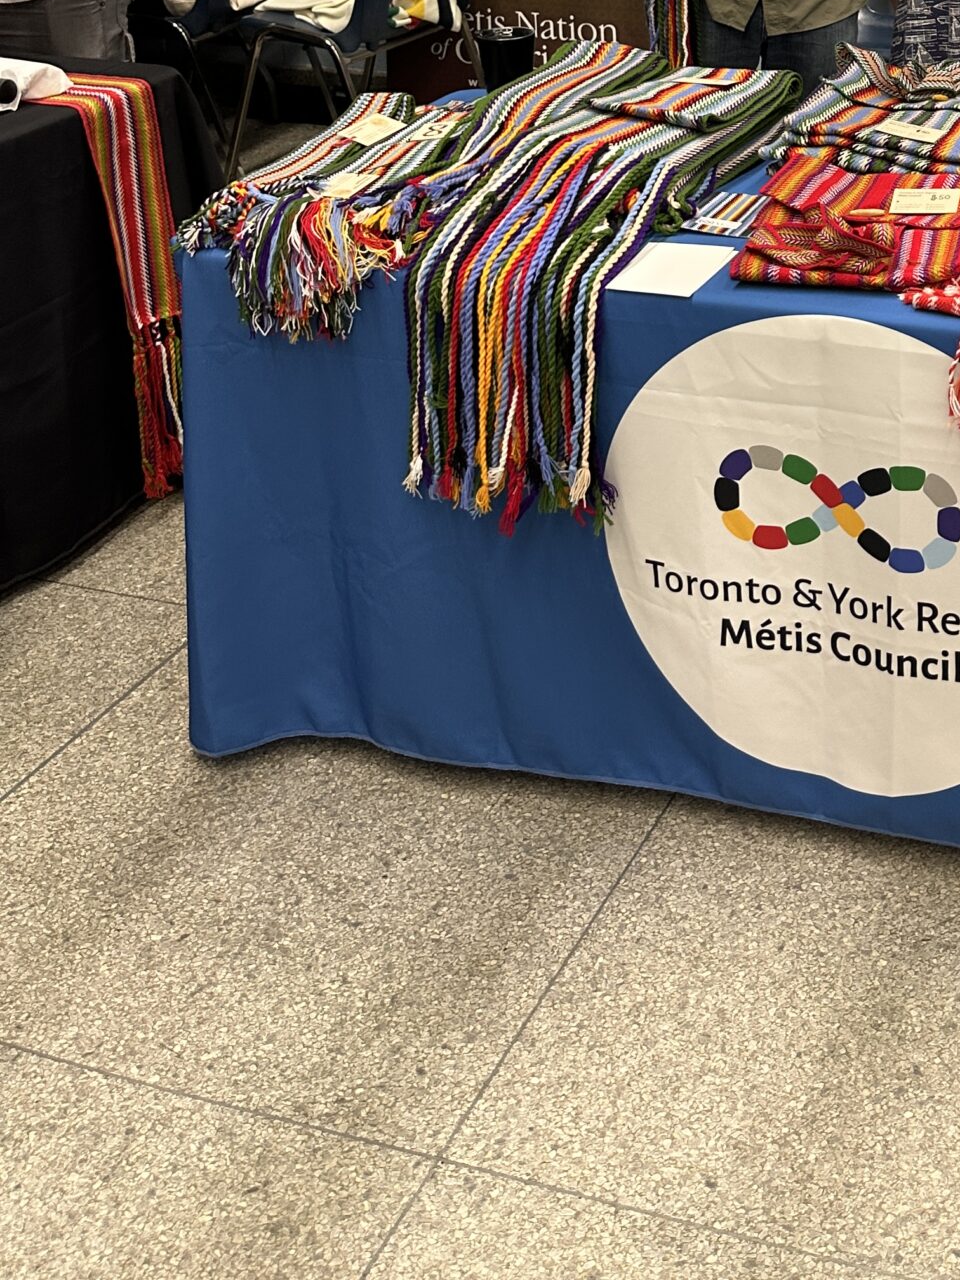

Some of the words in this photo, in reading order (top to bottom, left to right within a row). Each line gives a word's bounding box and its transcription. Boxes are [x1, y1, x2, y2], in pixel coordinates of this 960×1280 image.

[463, 4, 505, 33] étis
[515, 10, 617, 42] Nation
[430, 38, 453, 60] of
[645, 559, 782, 606] Toronto
[793, 579, 823, 612] &
[827, 582, 905, 631] York
[720, 618, 822, 654] Métis
